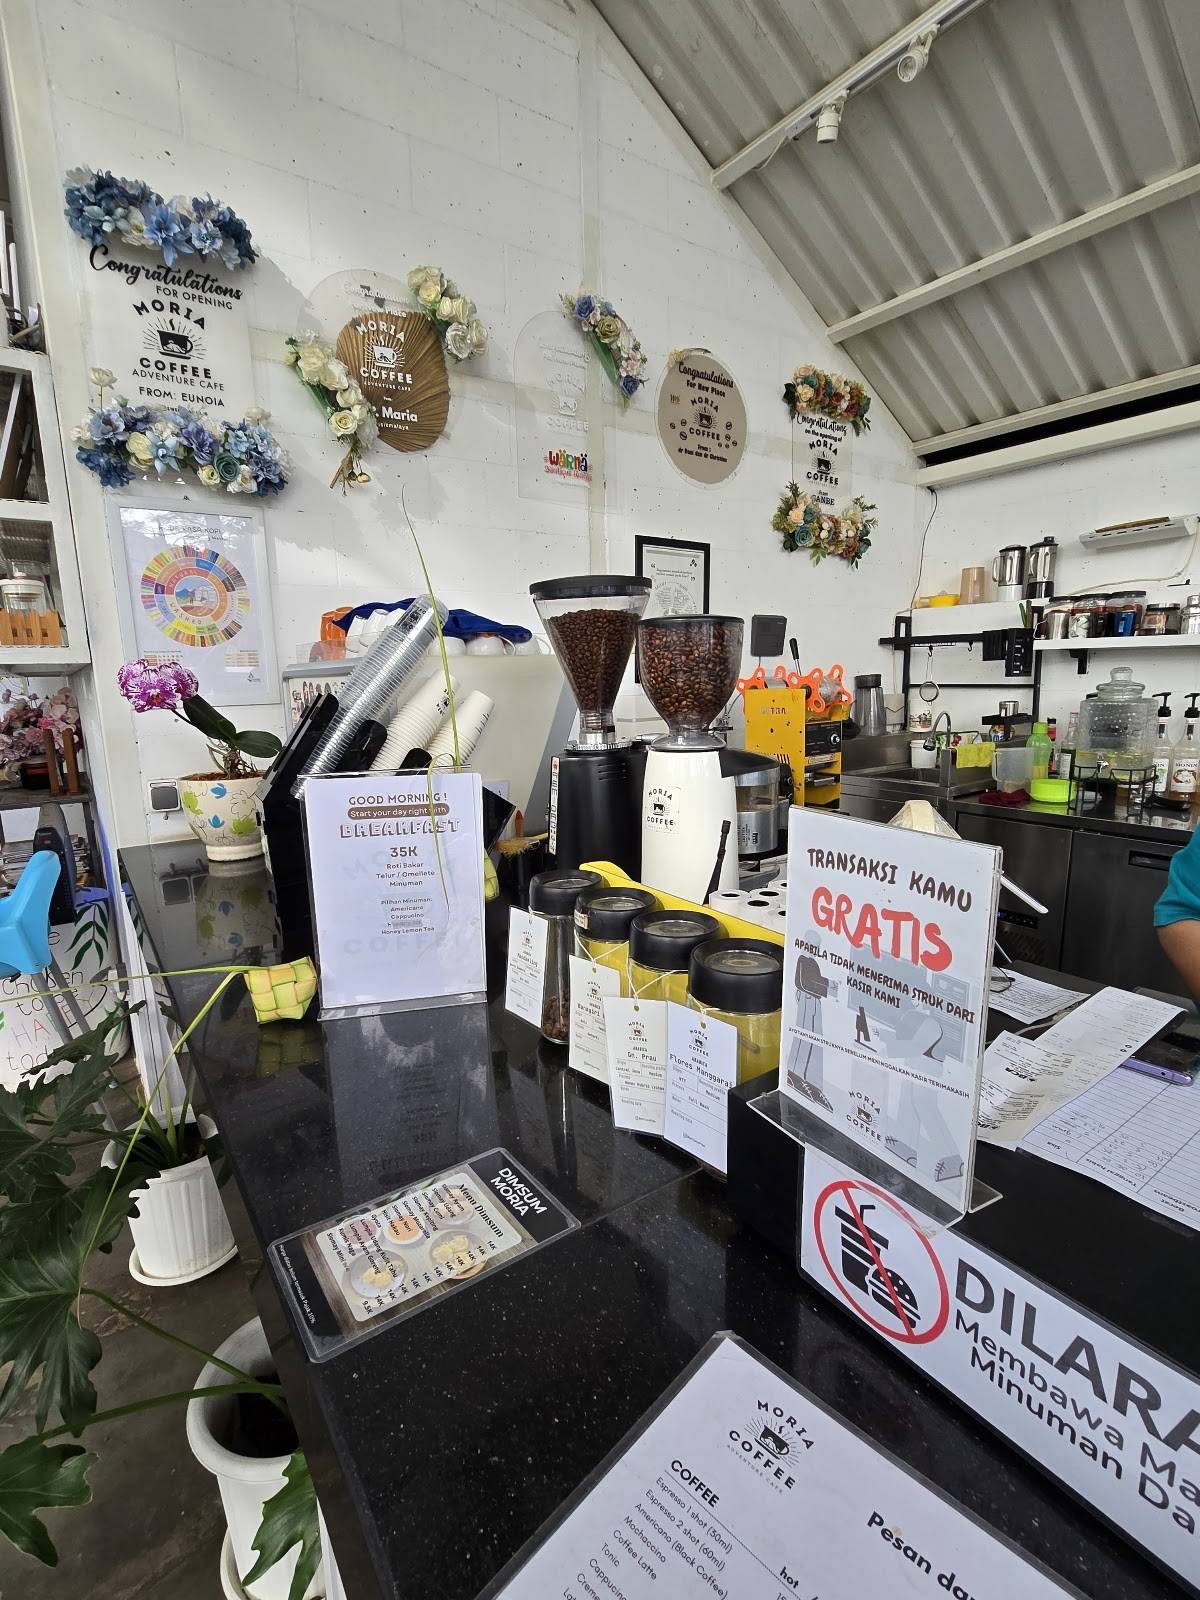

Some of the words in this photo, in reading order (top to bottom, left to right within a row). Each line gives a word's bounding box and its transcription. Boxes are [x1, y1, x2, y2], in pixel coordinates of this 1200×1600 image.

[89, 243, 243, 300] Congratulations
[133, 300, 205, 330] MORIA
[156, 286, 179, 299] FOR
[183, 292, 233, 310] OPENING
[355, 320, 405, 343] MORIA
[132, 368, 196, 387] ADVENTURE
[199, 379, 225, 391] CAFE
[140, 357, 212, 379] COFFEE
[360, 367, 413, 384] COFFEE
[679, 361, 734, 389] Congratulations
[181, 392, 225, 407] EUNOIA
[382, 406, 418, 422] Maria
[690, 396, 719, 413] MORIA
[689, 427, 721, 441] COFFEE
[809, 440, 838, 456] MORIA
[806, 471, 839, 486] COFFEE
[349, 796, 384, 806] GOOD
[388, 793, 441, 804] MORNING
[350, 808, 371, 818] Start
[372, 808, 391, 818] your
[392, 808, 407, 816] day
[408, 806, 428, 816] right
[340, 820, 460, 839] BREAKFAST
[390, 846, 418, 858] 35K
[807, 848, 898, 884] TRANSAKSI
[910, 870, 972, 912] KAMU
[812, 886, 952, 972] GRATIS
[794, 938, 828, 960] APABILA
[830, 952, 855, 977] TIDAK
[857, 966, 909, 996] MENERIMA
[912, 988, 943, 1010] STRUK
[946, 1004, 976, 1024] DARI
[846, 976, 872, 997] KASIR
[874, 989, 901, 1009] KAMI
[642, 1054, 657, 1062] Prau
[670, 1053, 693, 1070] Flores
[688, 1044, 710, 1057] COFFEE
[844, 1047, 867, 1060] SEBELUM
[910, 1072, 928, 1084] KASIR
[848, 1090, 882, 1114] MORIA
[846, 1114, 882, 1142] COFFEE
[457, 1182, 478, 1206] Menu
[475, 1204, 505, 1238] Dimsum
[490, 1177, 529, 1217] MORIA
[498, 1167, 548, 1214] DIMSUM
[390, 1204, 404, 1221] Siomay
[402, 1220, 412, 1232] Nori
[432, 1266, 443, 1277] 14K
[400, 1200, 414, 1216] Siomay
[443, 1260, 454, 1271] 14K
[410, 1196, 424, 1212] Siomay
[454, 1255, 465, 1266] 14K
[420, 1191, 435, 1208] Siomay
[465, 1250, 476, 1260] 14K
[430, 1187, 445, 1203] Siomay
[442, 1202, 456, 1218] Udang
[475, 1245, 486, 1255] 14K
[452, 1198, 464, 1212] Ayam
[486, 1240, 496, 1250] 14K
[347, 1223, 360, 1242] Lumpia
[357, 1240, 369, 1256] Ayam
[366, 1254, 380, 1275] Goreng
[385, 1288, 396, 1300] 14K
[359, 1218, 372, 1236] Lumpia
[369, 1235, 382, 1252] Udang
[387, 1263, 397, 1278] Tahu
[398, 1282, 408, 1294] 14K
[388, 1220, 400, 1236] Hakau
[421, 1271, 431, 1282] 14K
[326, 1232, 338, 1251] Siomay
[336, 1249, 345, 1263] Mini
[362, 1300, 371, 1315] 9.5K
[345, 1242, 355, 1256] Naga
[374, 1294, 384, 1306] 14K
[409, 1277, 420, 1288] 14K
[956, 1309, 1124, 1450] Membawa
[758, 1400, 814, 1450] MORIA
[971, 1346, 1124, 1480] Minuman
[1138, 1472, 1195, 1535] Da
[729, 1430, 796, 1489] COFFEE
[671, 1460, 720, 1508] COFFEE
[645, 1488, 676, 1522] Espresso
[676, 1520, 684, 1530] 2
[683, 1528, 700, 1548] shot
[699, 1543, 726, 1572] (60ml)
[656, 1476, 686, 1509] Espresso
[690, 1510, 708, 1530] shot
[706, 1525, 733, 1555] (30ml)
[600, 1542, 620, 1568] Tonic
[613, 1530, 638, 1559] Coffee
[638, 1556, 658, 1580] Latte
[624, 1515, 666, 1564] Mochaccino
[634, 1502, 672, 1544] Americano
[671, 1540, 696, 1568] (Black
[696, 1564, 728, 1600] Coffee)
[867, 1510, 932, 1574] Pesan
[780, 1566, 799, 1589] hot
